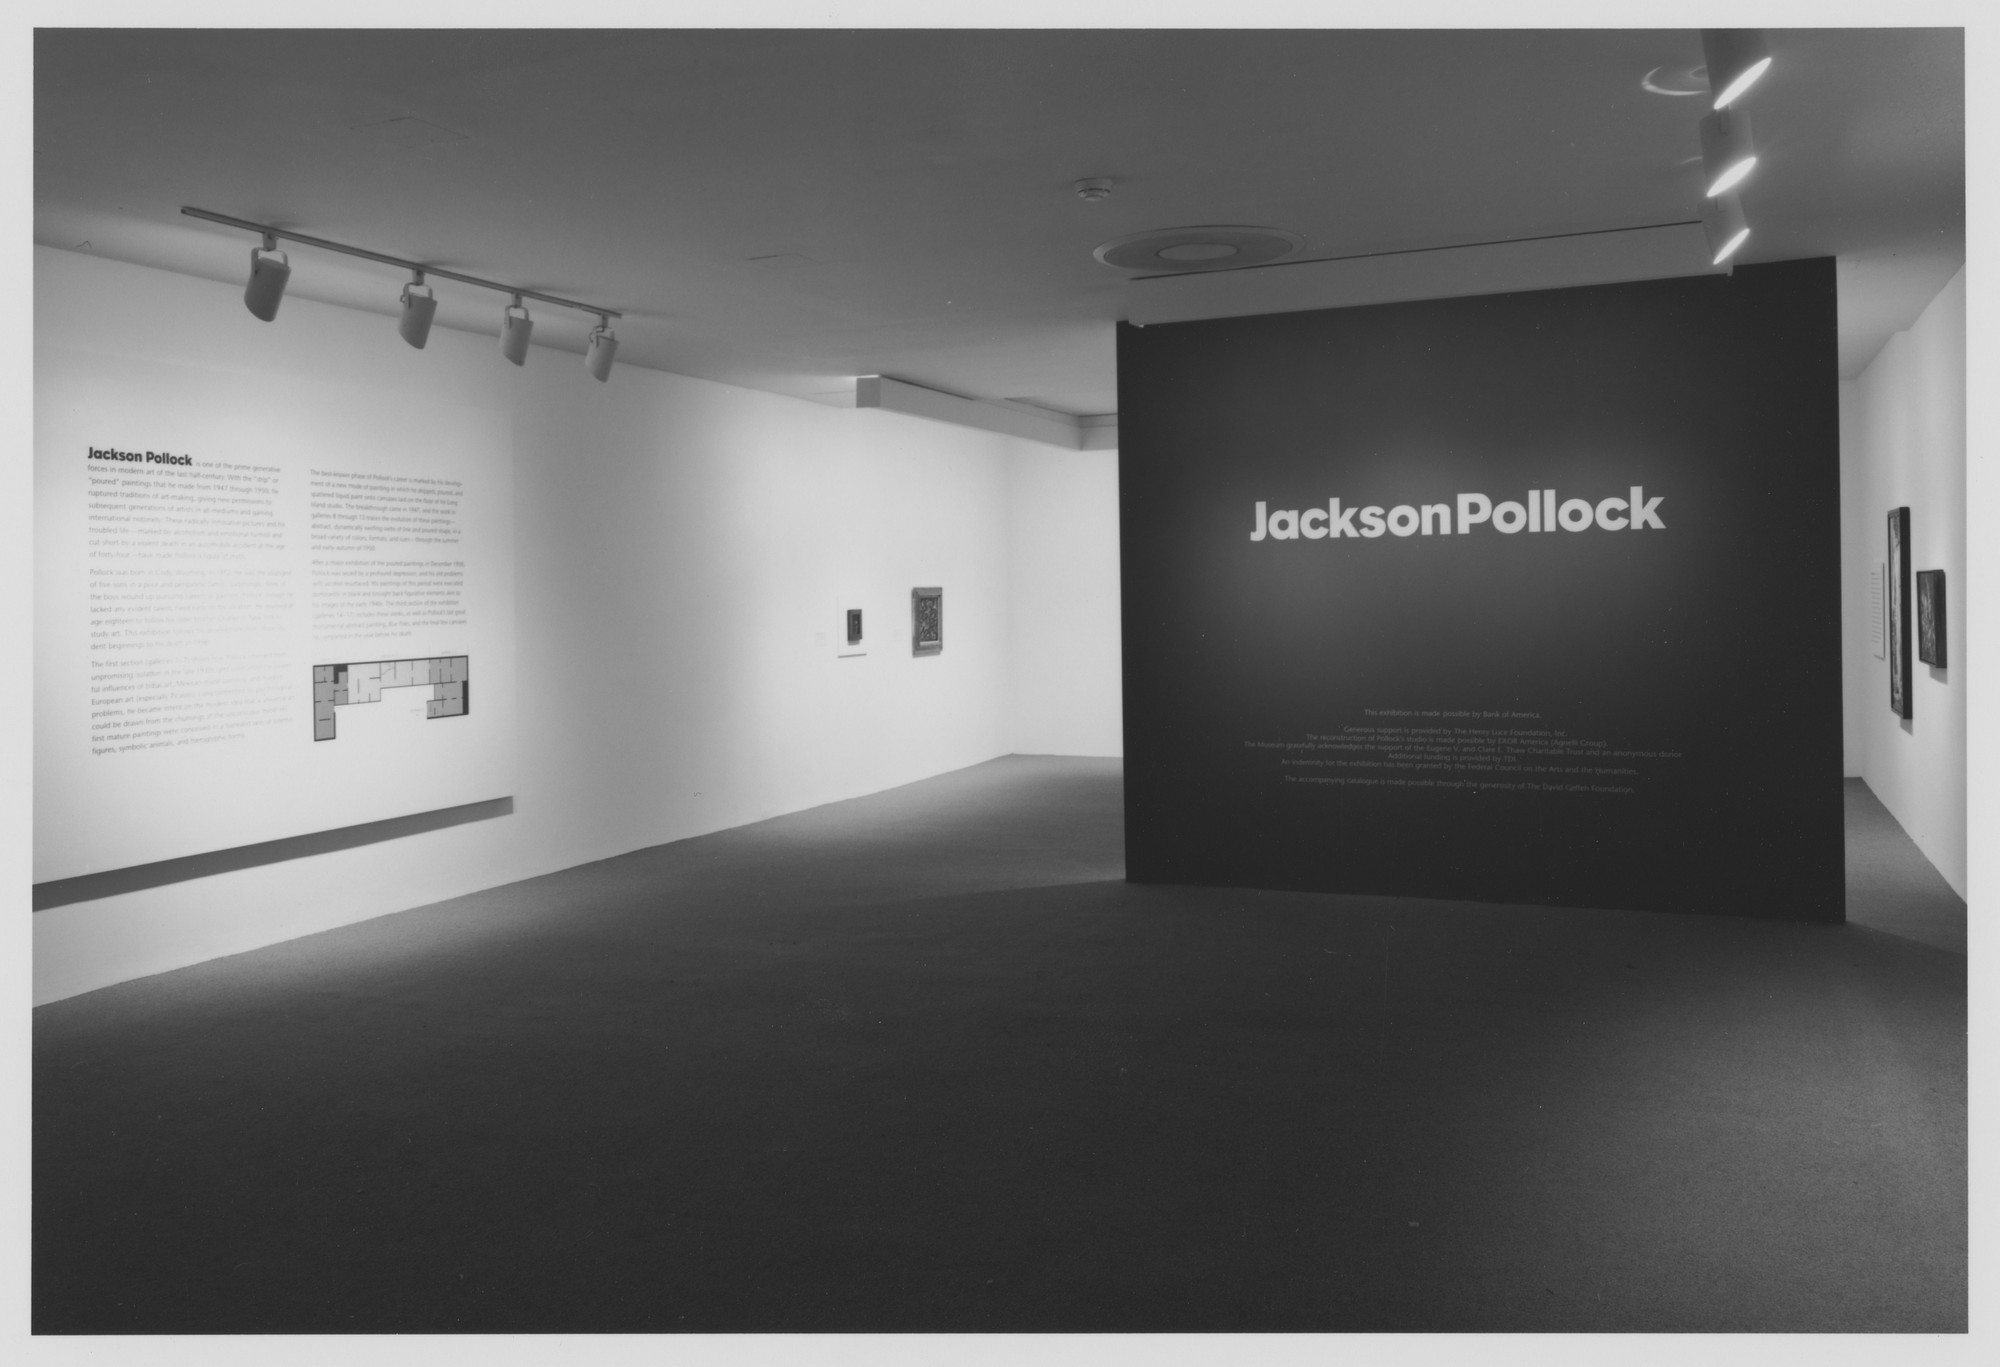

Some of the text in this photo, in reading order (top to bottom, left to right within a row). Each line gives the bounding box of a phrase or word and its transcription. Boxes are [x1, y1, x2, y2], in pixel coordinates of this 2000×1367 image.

[87, 447, 192, 466] Jackson Pollock
[91, 673, 133, 682] unpromising
[1443, 710, 1470, 719] possible
[133, 730, 161, 739] paintings
[1377, 727, 1401, 735] support
[1411, 728, 1441, 736] provided
[1469, 729, 1489, 737] Henry
[1510, 729, 1552, 737] Foundation,
[1457, 737, 1485, 746] possible
[1580, 740, 1608, 748] Group).
[1287, 742, 1315, 751] gratefully
[1318, 743, 1362, 752] acknowledges
[1378, 744, 1403, 753] support
[1427, 745, 1451, 754] Eugene
[1614, 751, 1656, 759] anonymous
[1424, 754, 1450, 762] funding
[1460, 755, 1490, 763] provided
[1292, 759, 1323, 768] indemnity
[1415, 763, 1441, 771] granted
[1298, 776, 1345, 785] accompanying
[1347, 778, 1378, 787] catalogue
[1408, 780, 1434, 788] possible
[1437, 780, 1464, 789] through
[1480, 782, 1515, 791] generosity
